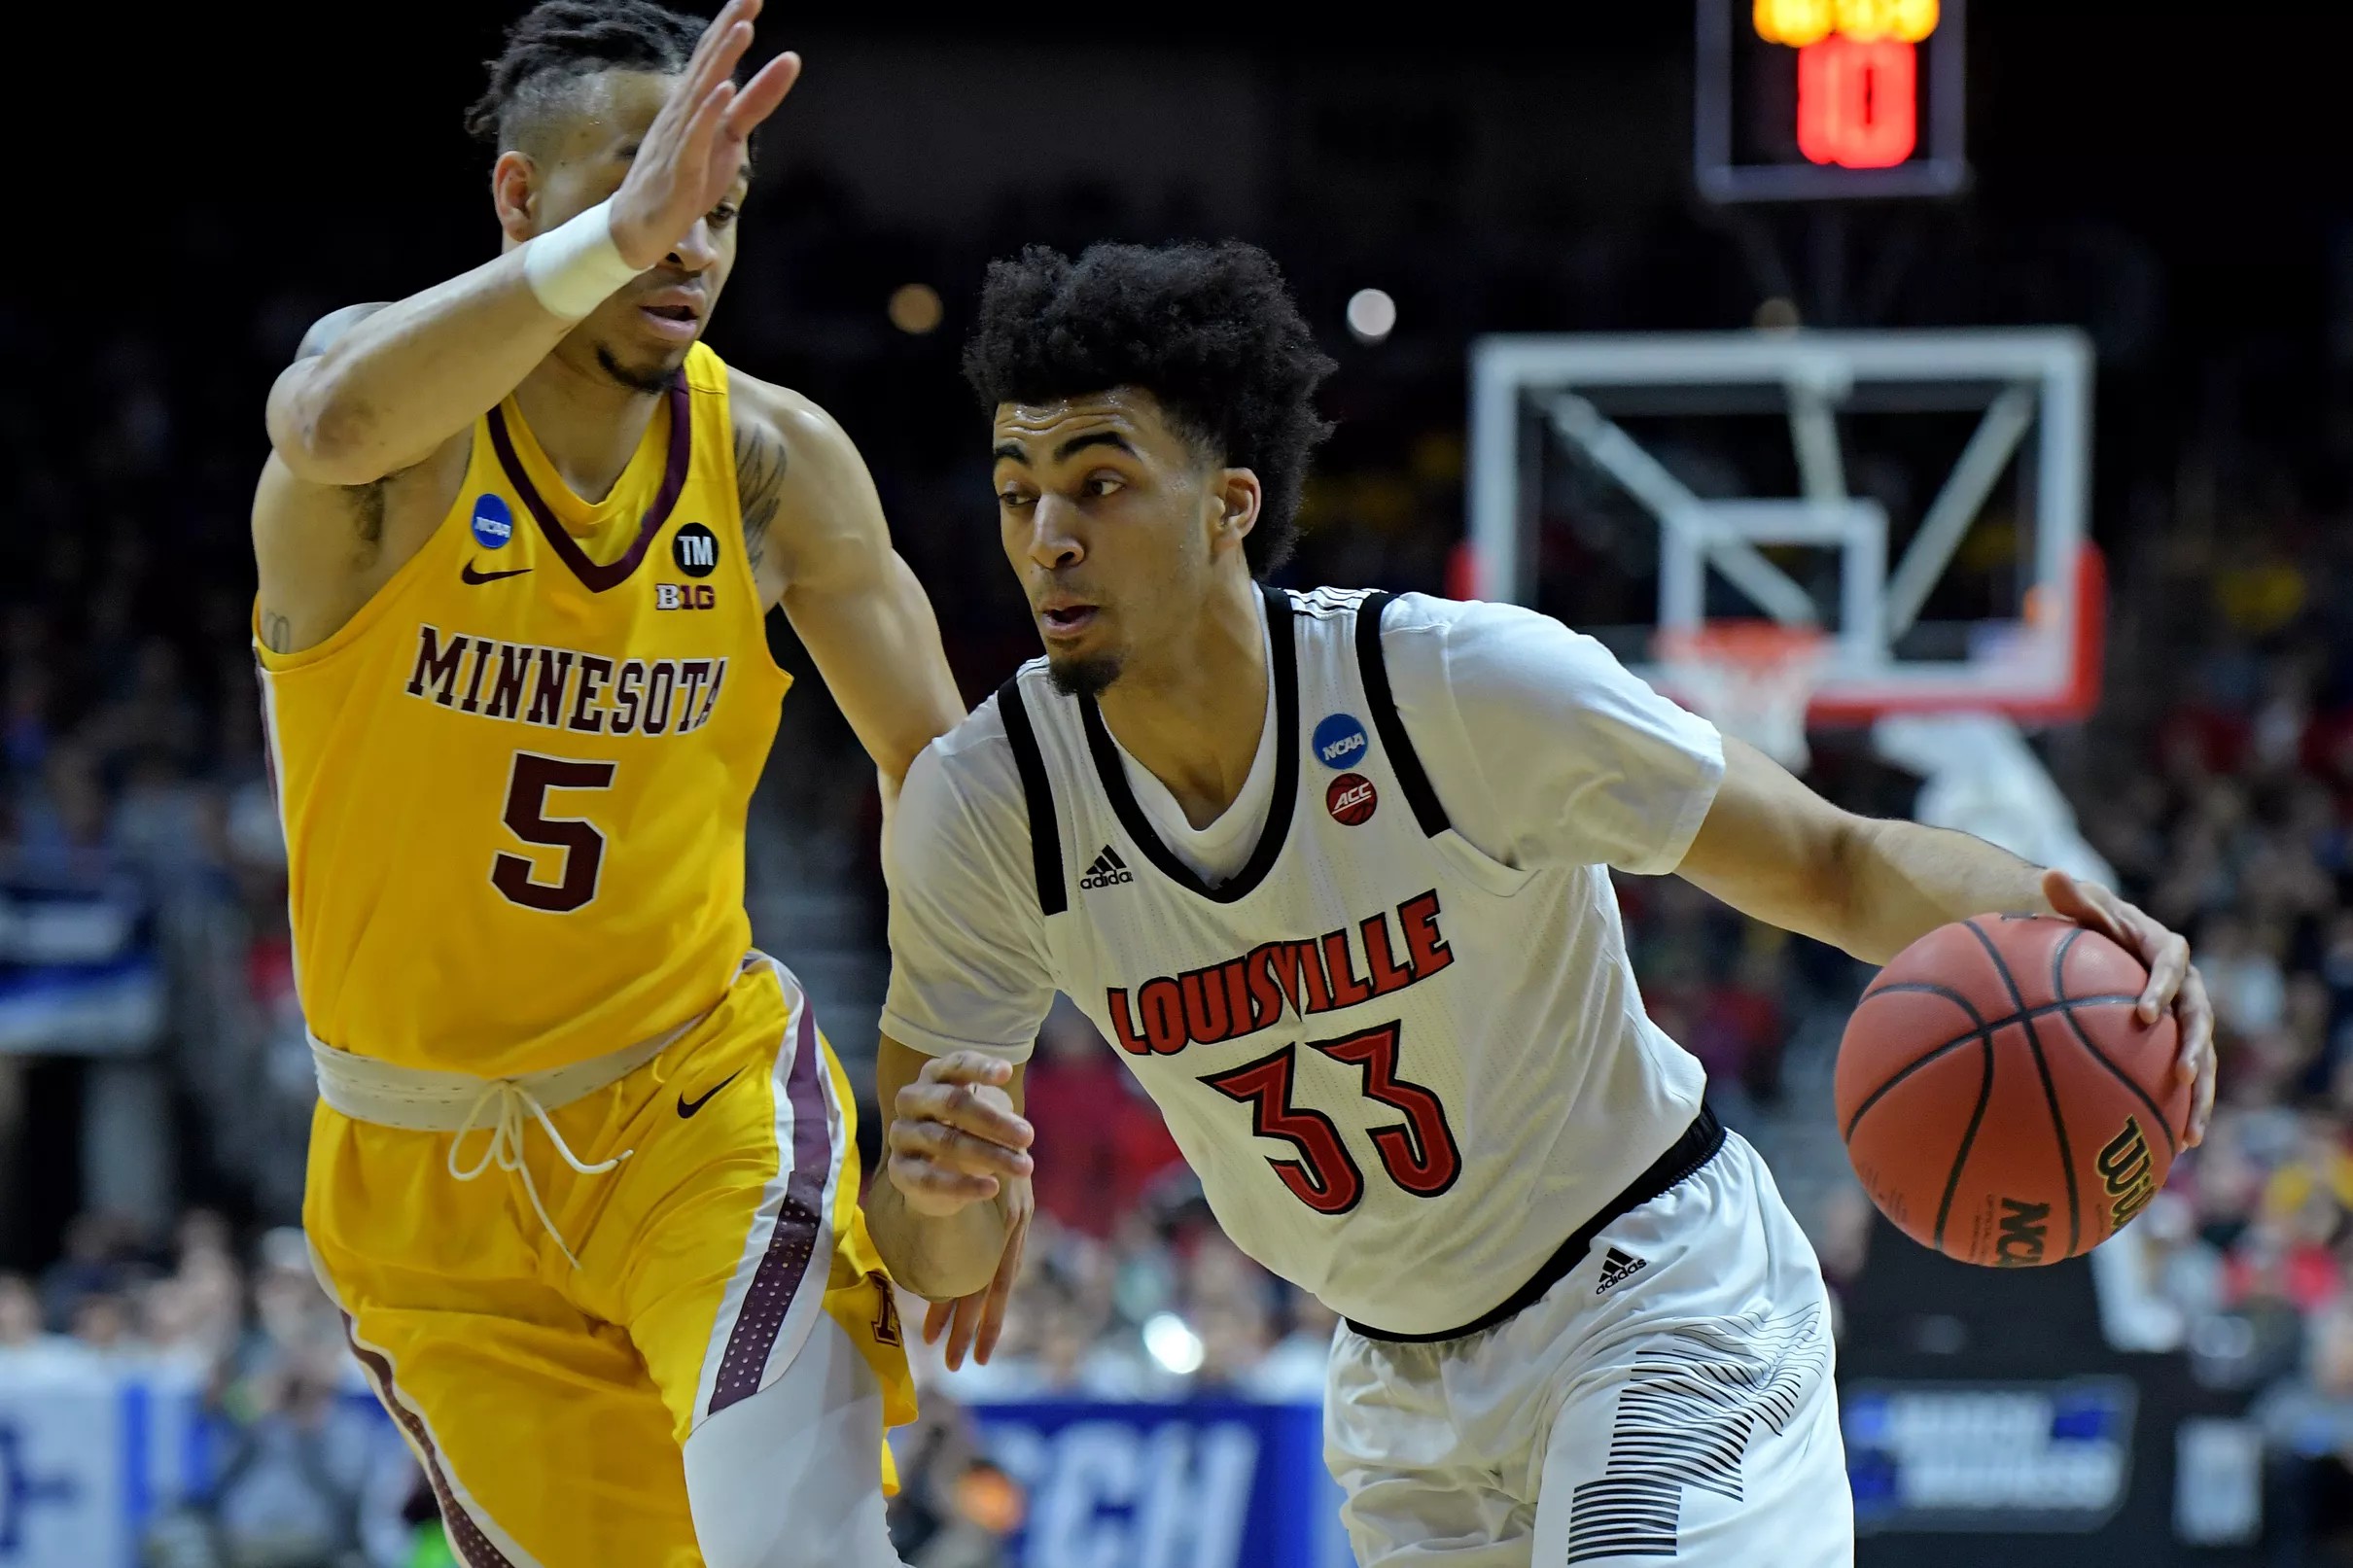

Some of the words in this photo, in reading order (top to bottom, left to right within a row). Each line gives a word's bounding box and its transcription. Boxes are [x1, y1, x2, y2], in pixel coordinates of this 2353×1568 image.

[678, 536, 714, 566] TM
[1322, 732, 1365, 760] NCAA
[489, 749, 619, 914] 5
[1333, 782, 1372, 811] ACC
[1106, 888, 1455, 1057] LOUISVILLE
[1196, 1018, 1462, 1215] 33
[2096, 1113, 2158, 1233] Wil
[1996, 1197, 2051, 1268] NC
[1596, 1258, 1647, 1295] adidas
